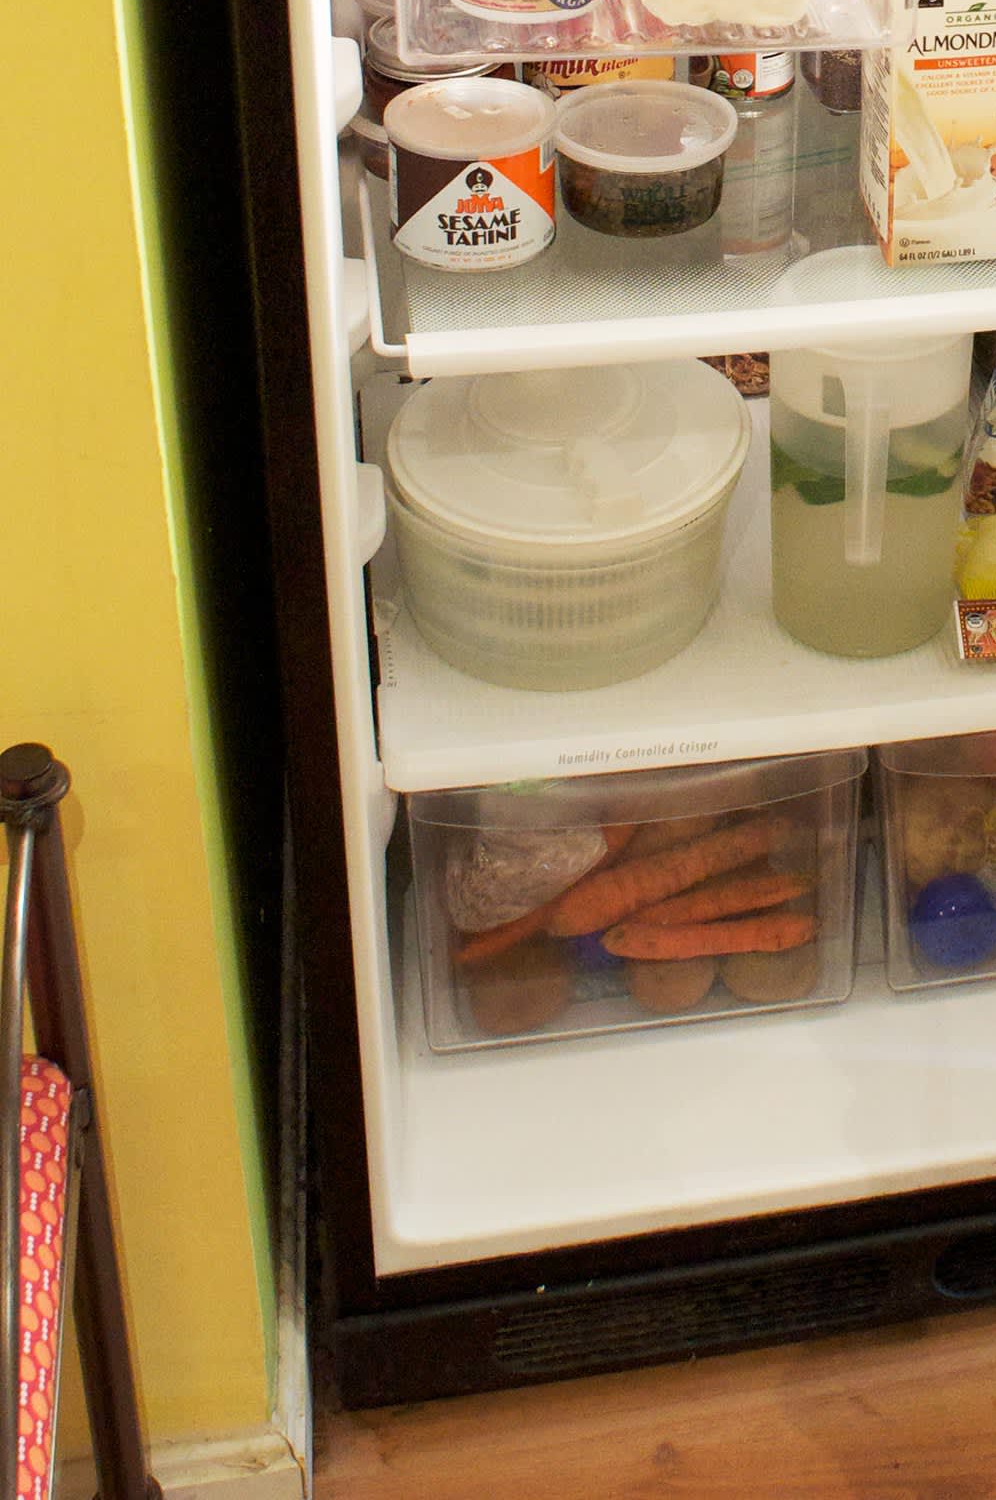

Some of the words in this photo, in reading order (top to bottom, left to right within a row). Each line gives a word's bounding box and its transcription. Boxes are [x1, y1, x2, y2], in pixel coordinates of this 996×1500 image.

[438, 208, 521, 231] SESAME
[444, 225, 517, 246] TAHINI
[558, 748, 611, 766] Humidity
[615, 743, 675, 762] Controlled
[678, 740, 719, 757] Crisper
